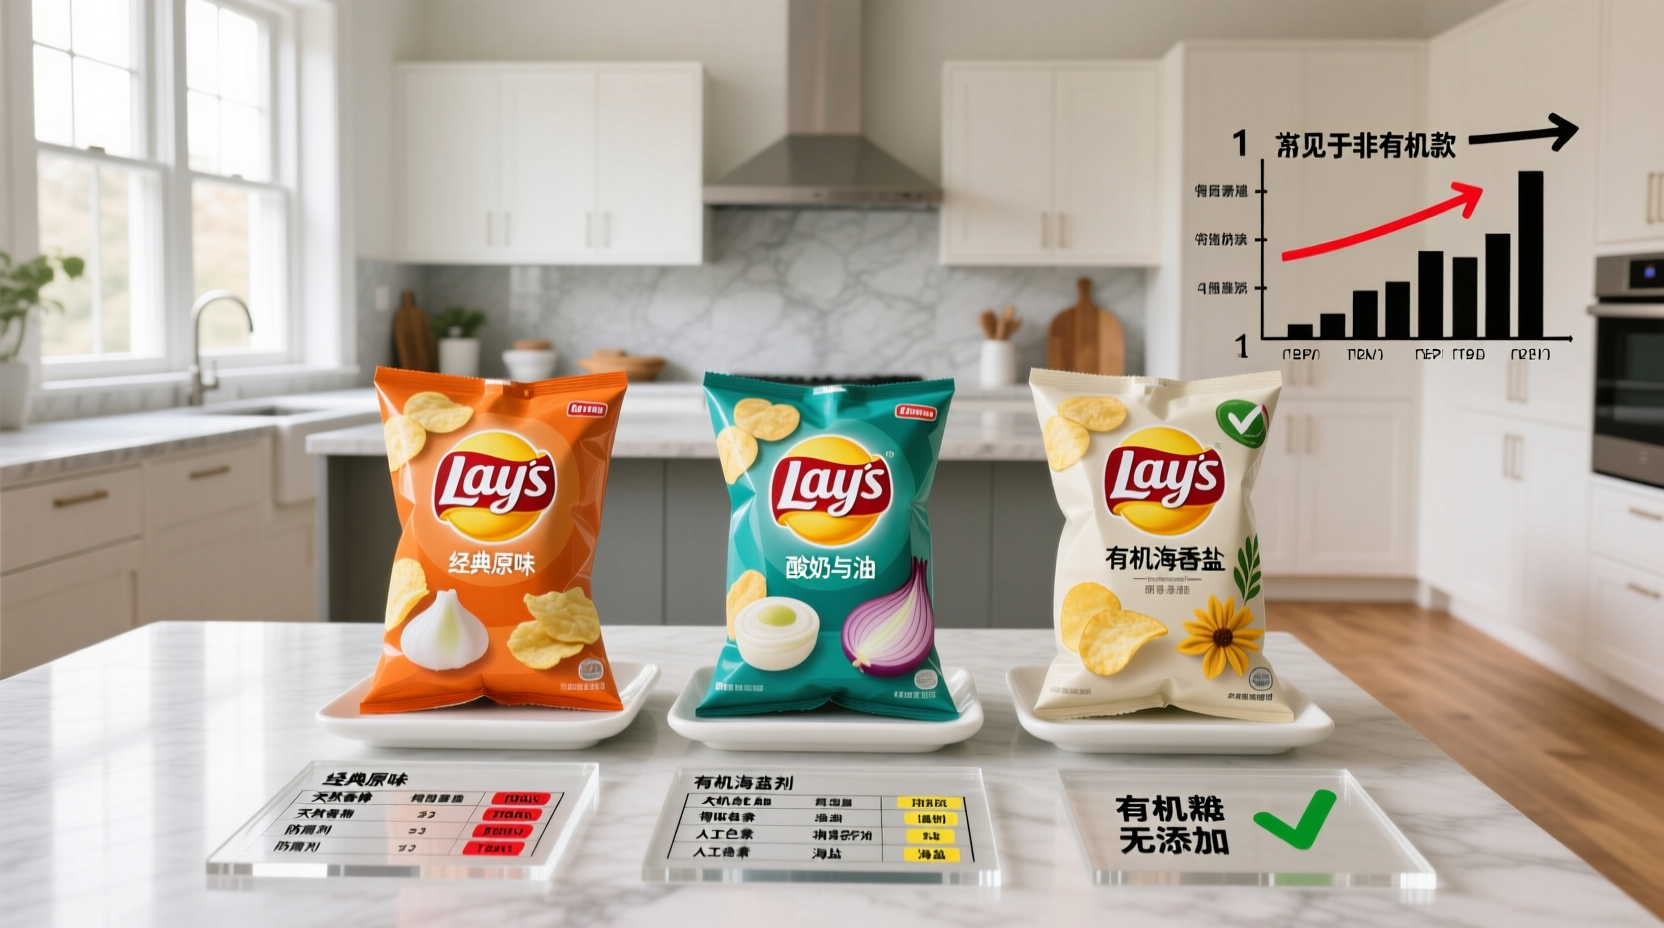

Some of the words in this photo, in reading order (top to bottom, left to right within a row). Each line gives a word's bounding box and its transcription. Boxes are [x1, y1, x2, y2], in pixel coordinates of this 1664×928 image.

[438, 455, 550, 514] Lay's
[777, 460, 885, 518] Lay's
[1109, 449, 1219, 509] Lay's
[448, 550, 536, 577] 经典原味
[785, 554, 876, 580] 酸奶与油
[1105, 545, 1226, 572] 有机海香盐
[321, 772, 409, 787] 经典原味
[1119, 826, 1230, 855] 无添加
